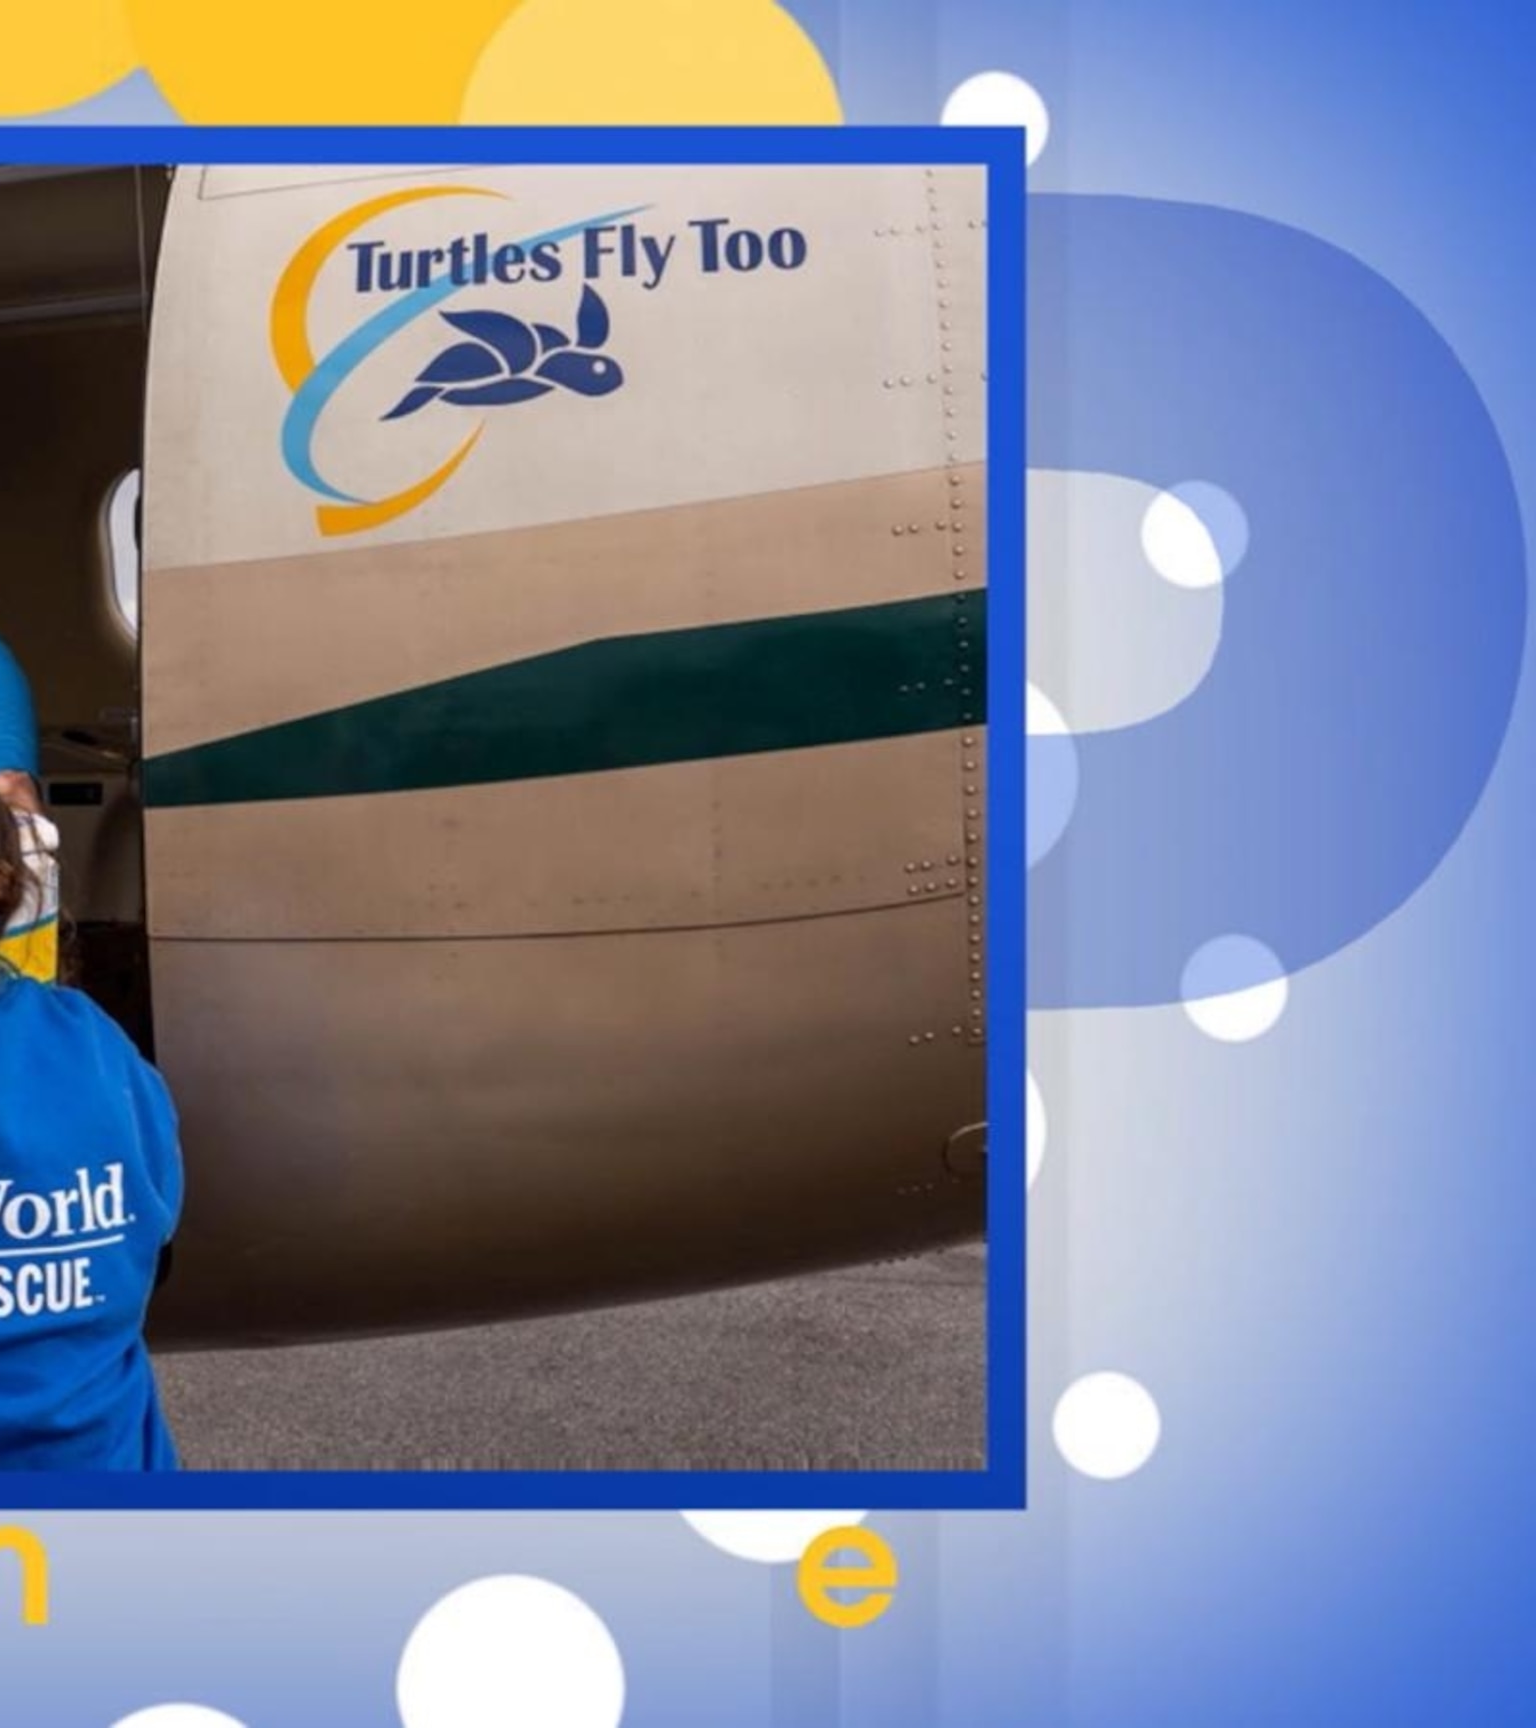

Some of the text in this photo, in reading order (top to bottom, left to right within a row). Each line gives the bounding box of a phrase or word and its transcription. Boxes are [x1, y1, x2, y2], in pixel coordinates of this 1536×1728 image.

[348, 218, 807, 293] Turtles Fly Too
